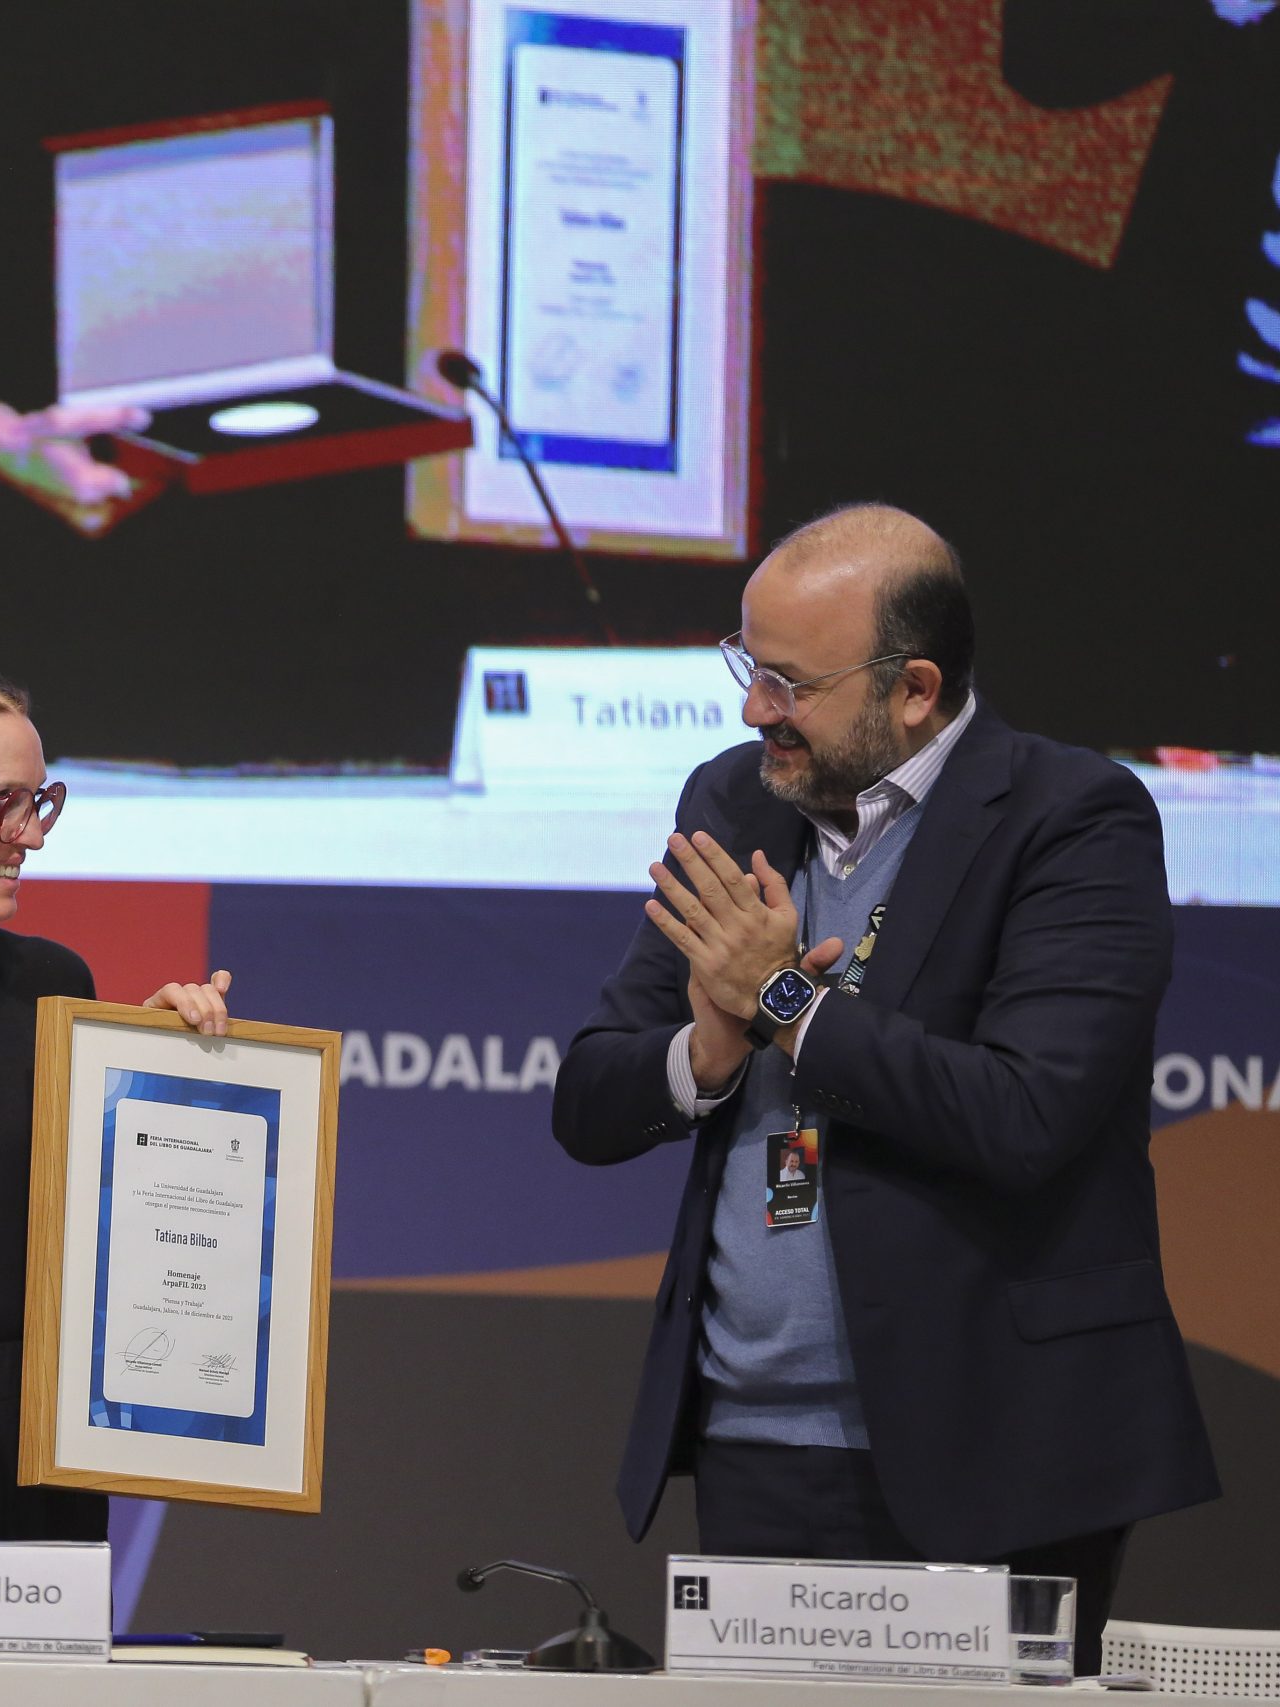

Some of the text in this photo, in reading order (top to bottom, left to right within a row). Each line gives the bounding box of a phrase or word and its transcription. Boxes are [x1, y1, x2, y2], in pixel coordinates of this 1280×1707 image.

[570, 693, 723, 728] Tatiana
[164, 1137, 199, 1146] INTERNACIONAL
[161, 1183, 188, 1191] Universidad
[196, 1188, 223, 1196] Guadalajara
[155, 1192, 186, 1201] Internacional
[216, 1199, 243, 1208] Guadalajara
[190, 1207, 226, 1216] reconocimiento
[155, 1228, 218, 1248] Tatiana Bilbao
[168, 1270, 200, 1281] Homenaje
[162, 1279, 189, 1288] ArpaFIL
[191, 1311, 214, 1319] diciembre
[790, 1584, 910, 1612] Ricardo
[710, 1618, 991, 1652] Villanueva Lomelí
[44, 1642, 53, 1650] de
[937, 1667, 948, 1675] de
